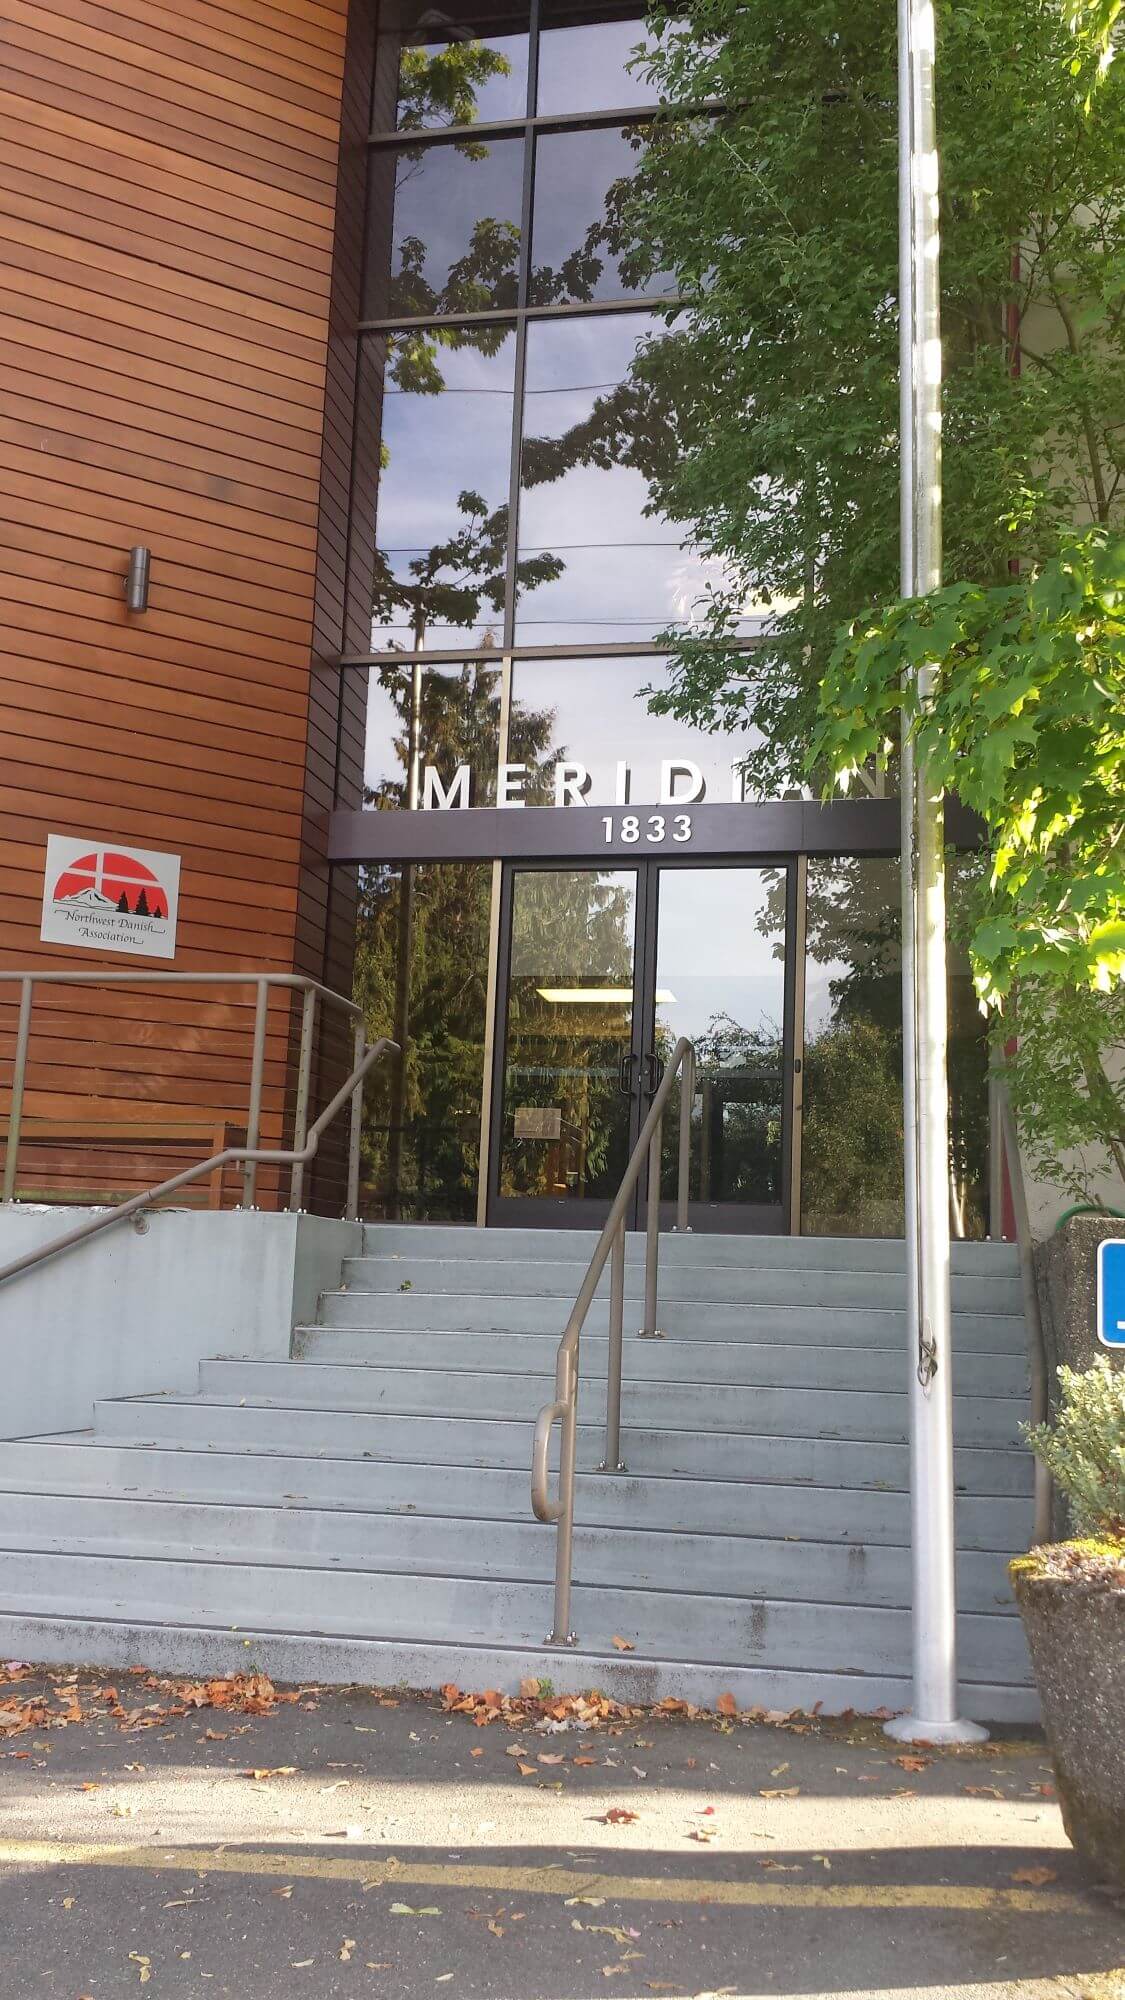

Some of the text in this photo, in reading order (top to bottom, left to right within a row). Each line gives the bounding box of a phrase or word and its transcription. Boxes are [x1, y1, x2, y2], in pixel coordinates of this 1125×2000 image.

[602, 814, 693, 843] 1833
[55, 909, 166, 933] Northwest Danish
[78, 927, 144, 945] Association
